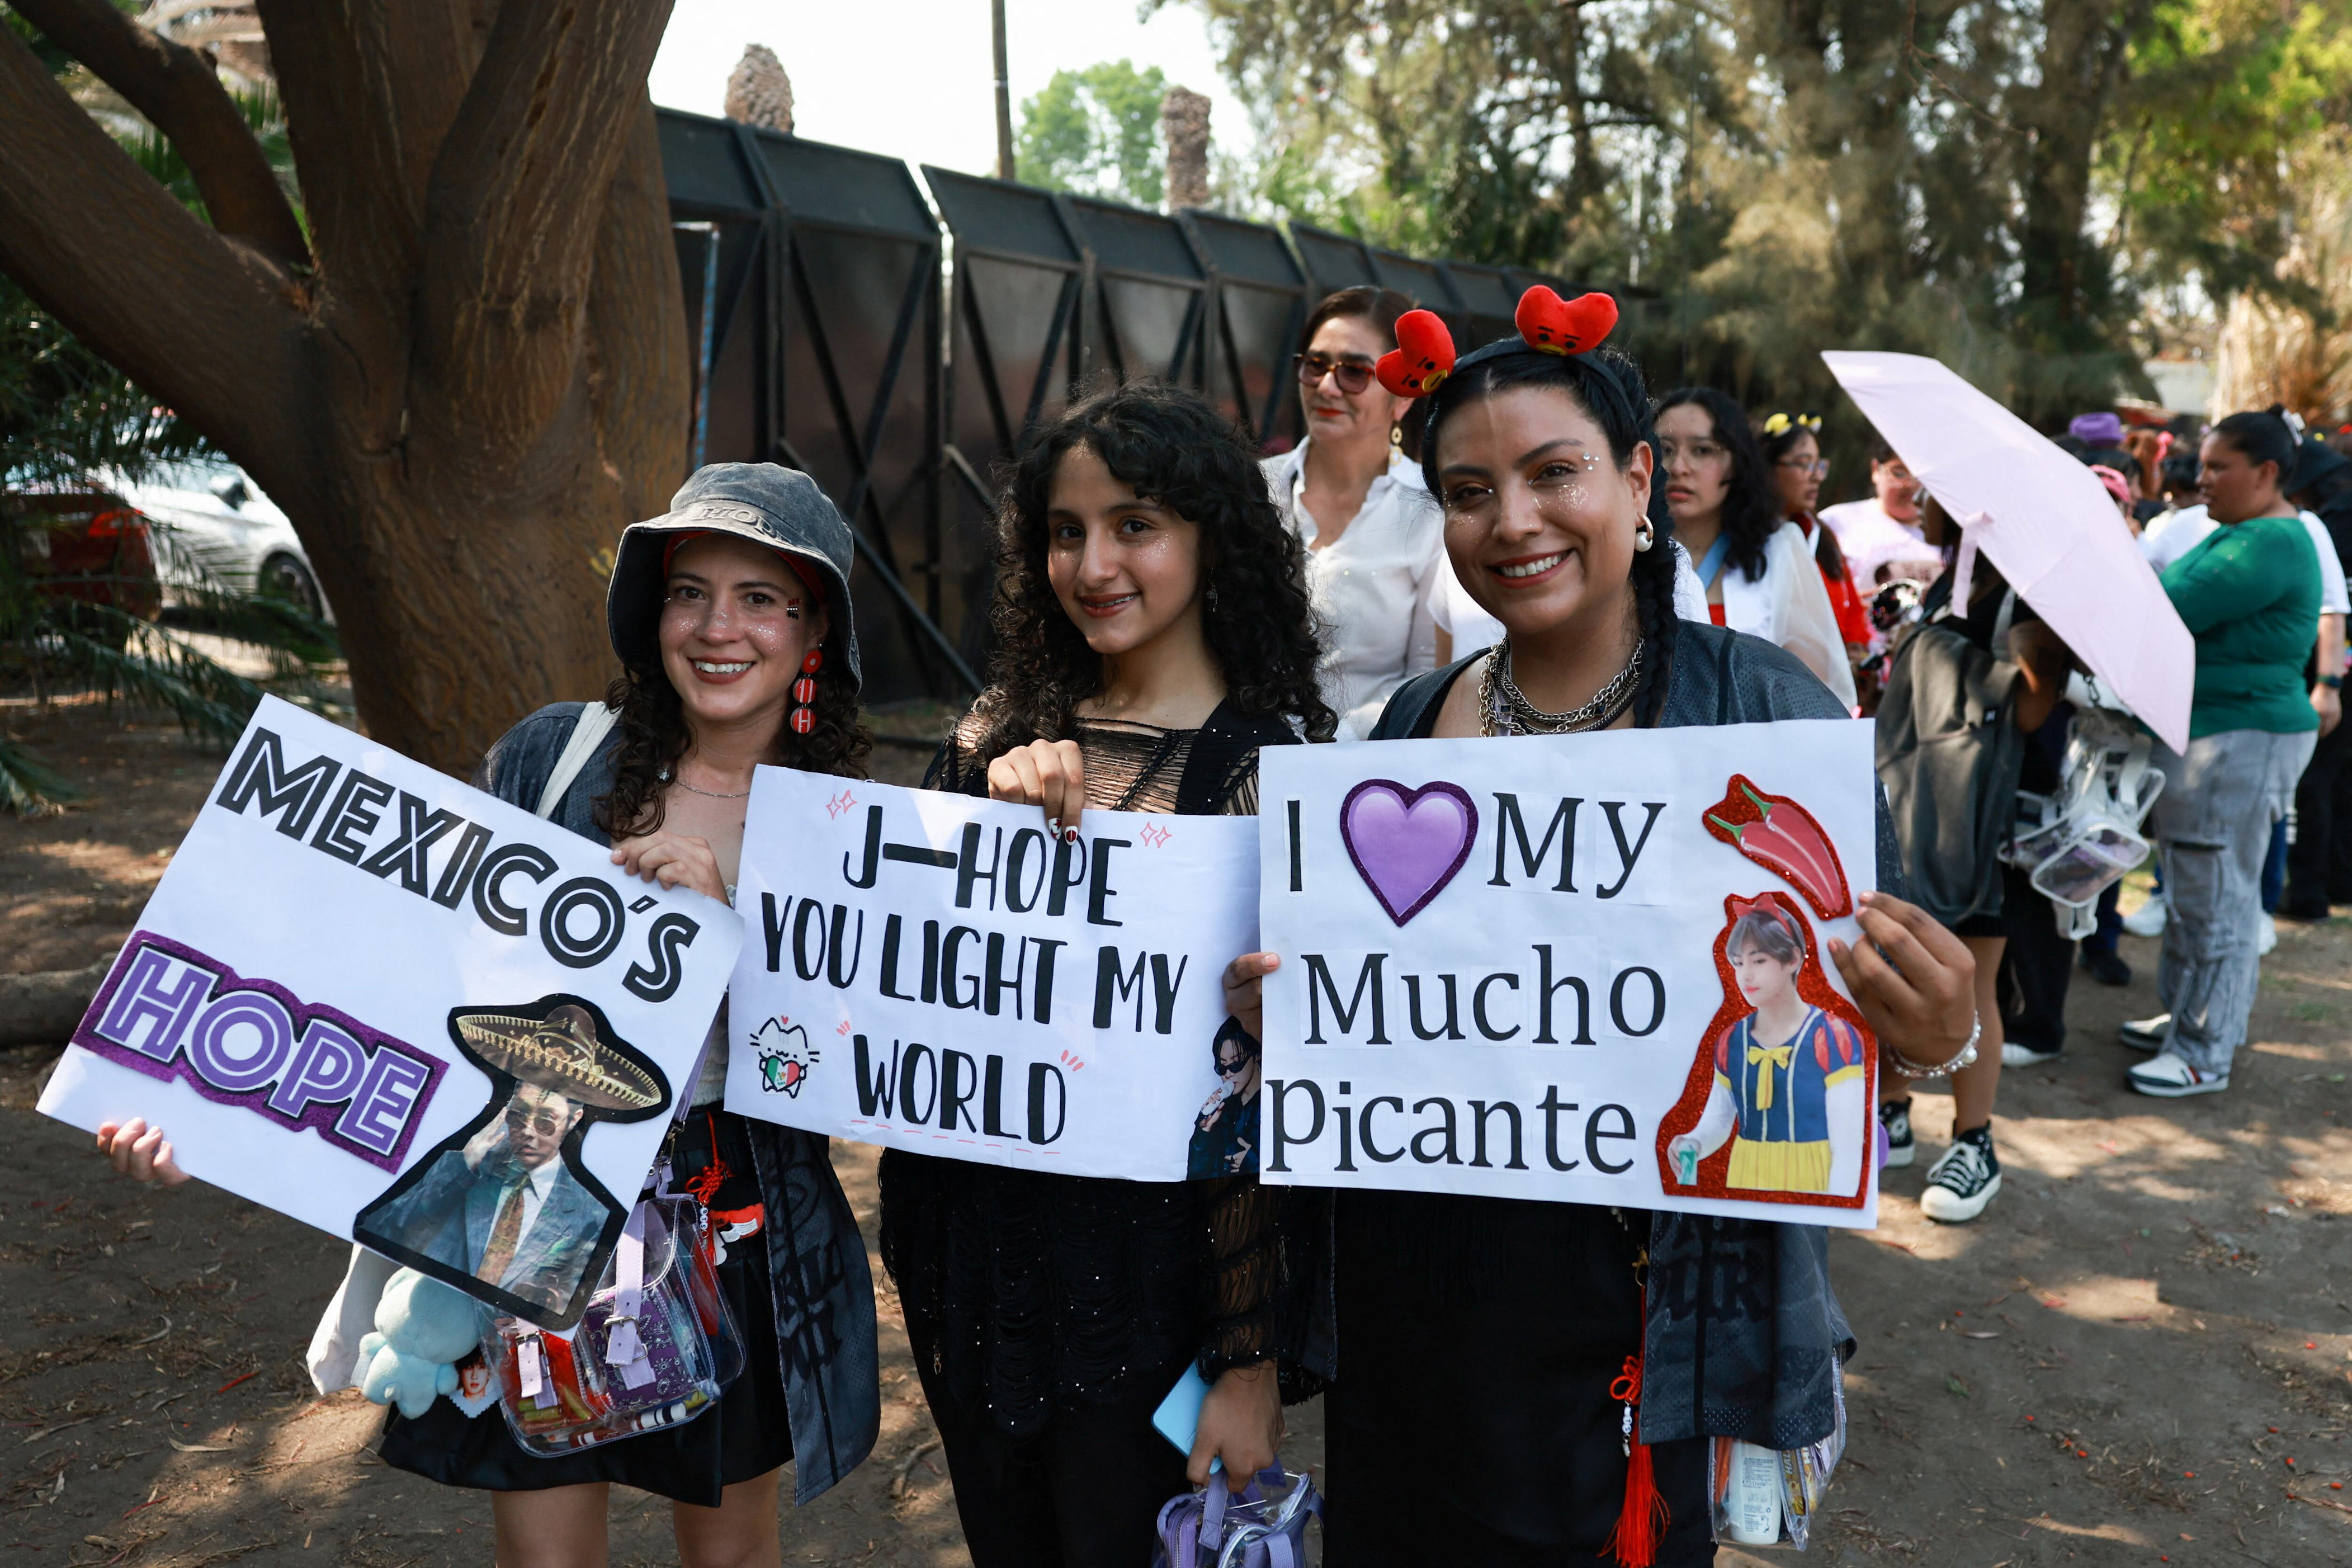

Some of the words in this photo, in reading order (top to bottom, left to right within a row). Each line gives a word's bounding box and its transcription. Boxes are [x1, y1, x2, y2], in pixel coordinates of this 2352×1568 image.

[215, 726, 701, 1003] MEXICO'S
[842, 804, 1132, 927] J-HOPE
[1287, 799, 1303, 892] I
[1486, 792, 1667, 900] My
[761, 891, 864, 990] YOU
[879, 913, 1069, 1025] LIGHT
[1092, 945, 1189, 1035] MY
[1300, 944, 1666, 1046] Mucho
[93, 943, 433, 1158] HOPE
[852, 1033, 1066, 1146] WORLD
[1264, 1079, 1637, 1175] picante
[1783, 1450, 1793, 1475] HAL
